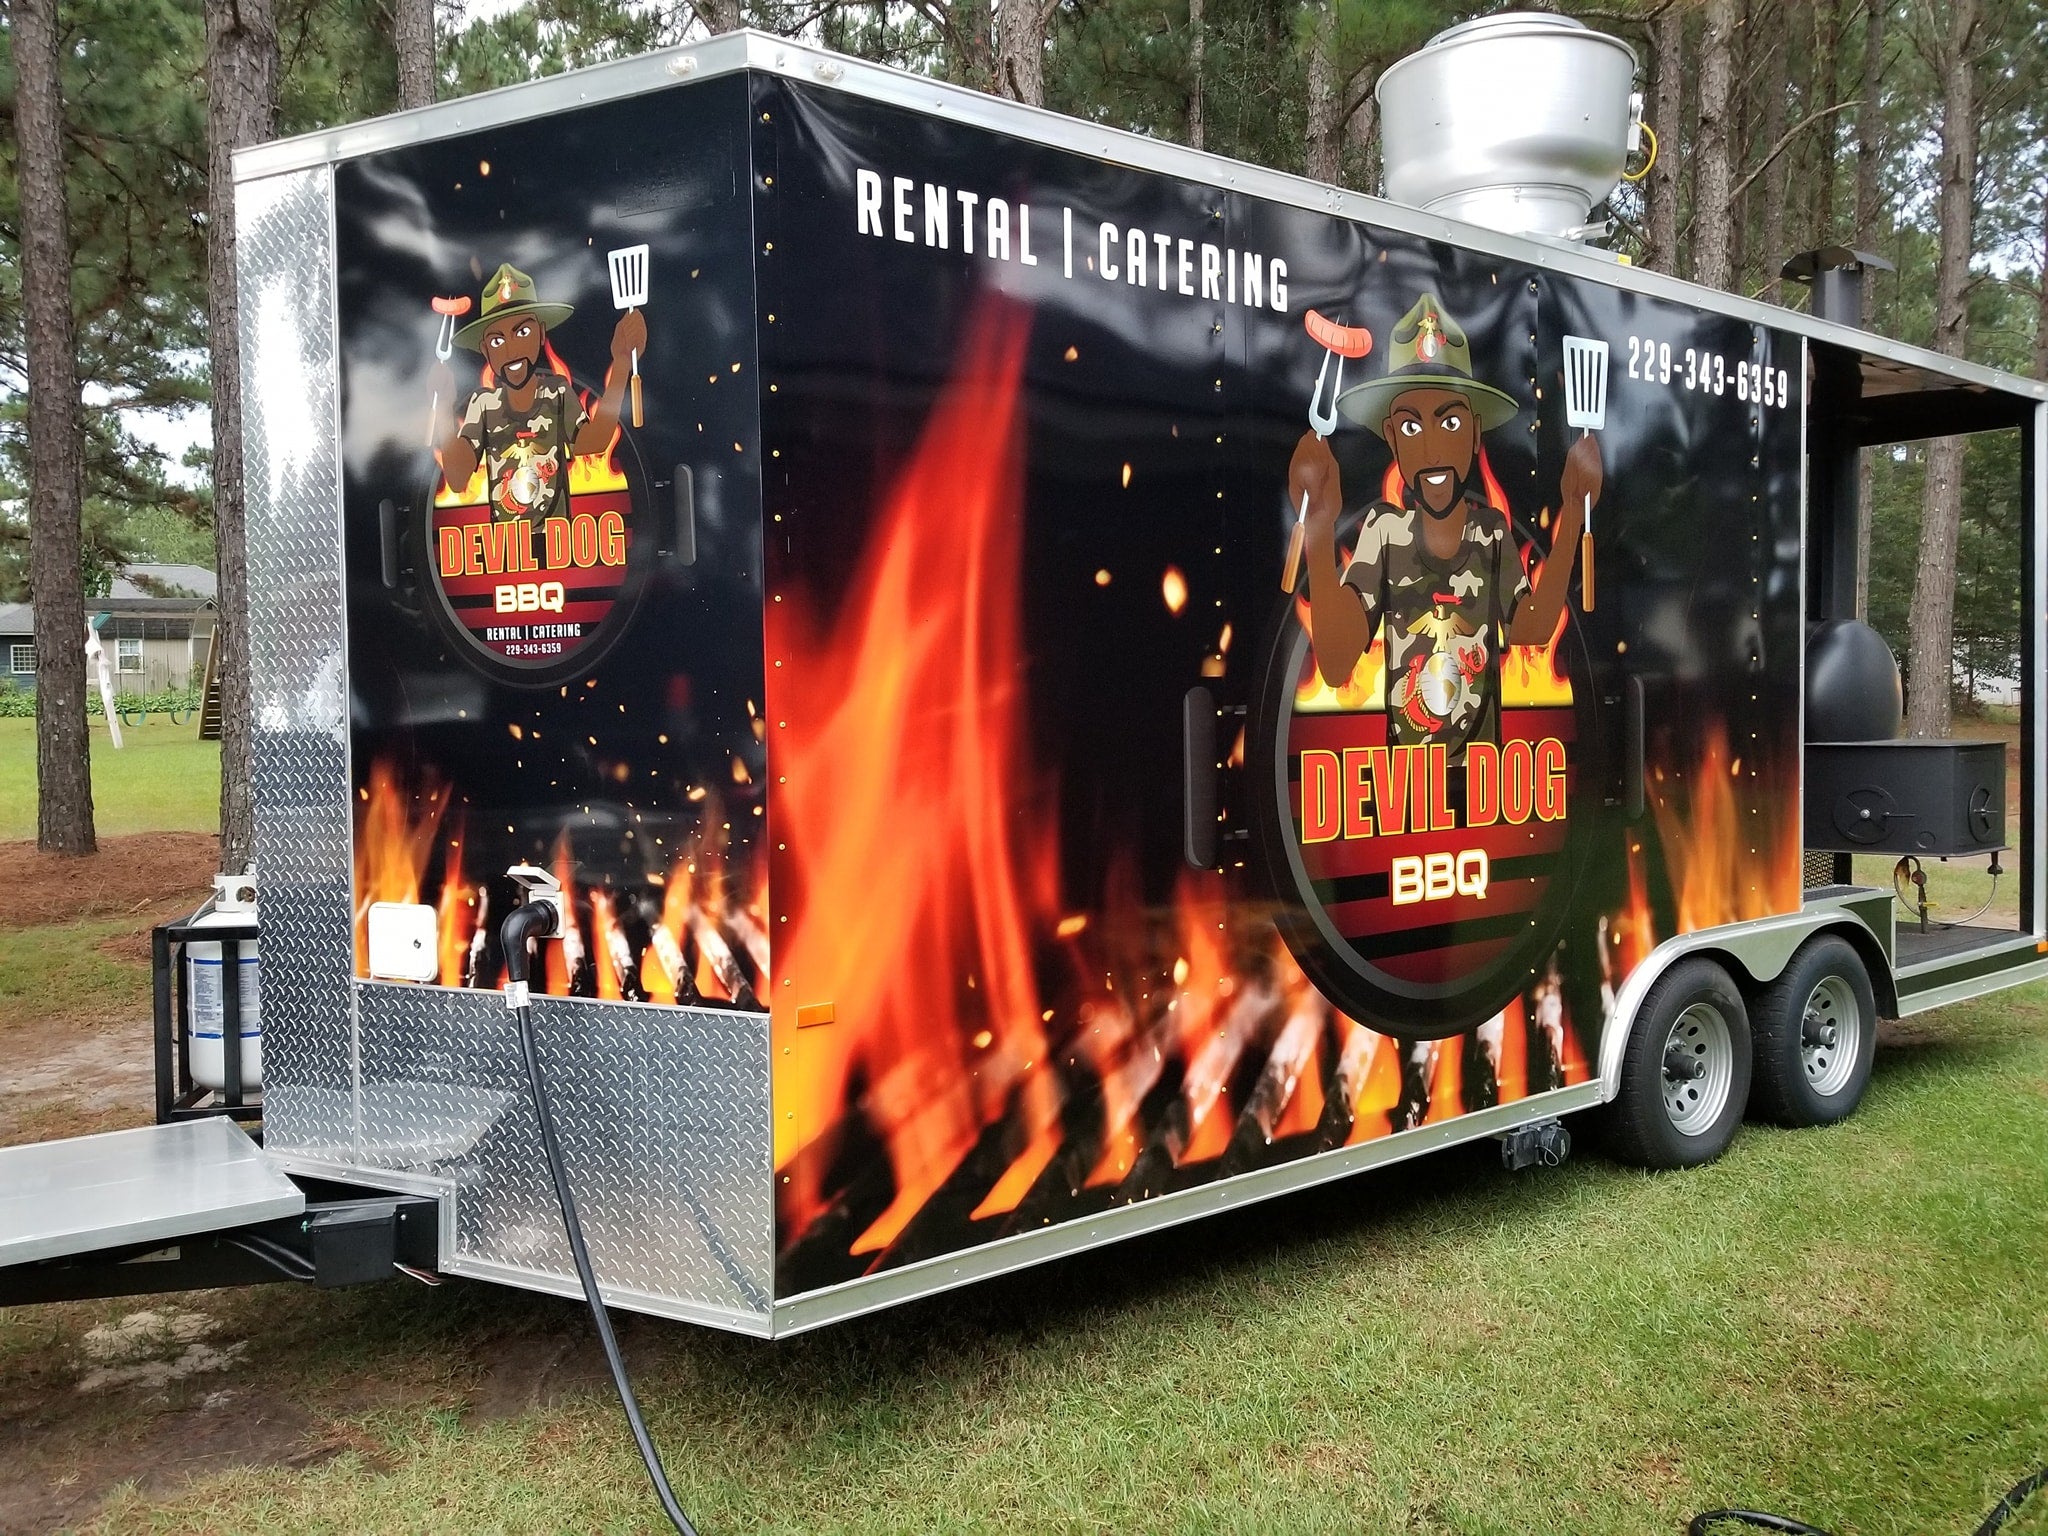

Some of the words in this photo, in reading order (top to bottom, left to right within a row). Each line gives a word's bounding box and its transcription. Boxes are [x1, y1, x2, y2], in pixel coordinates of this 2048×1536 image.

[856, 168, 1037, 266] RENTAL
[1099, 222, 1288, 313] CATERING
[1628, 335, 1788, 409] 229-343-6359
[439, 519, 538, 577] DEVIL
[544, 511, 626, 569] DOG
[494, 581, 565, 613] BBQ
[486, 625, 522, 641] RENTAL
[532, 623, 581, 640] CATERING
[505, 642, 562, 655] 229-343-6359
[1301, 743, 1455, 844] DEVIL
[1466, 737, 1567, 828] DOG
[1391, 848, 1489, 906] BBQ
